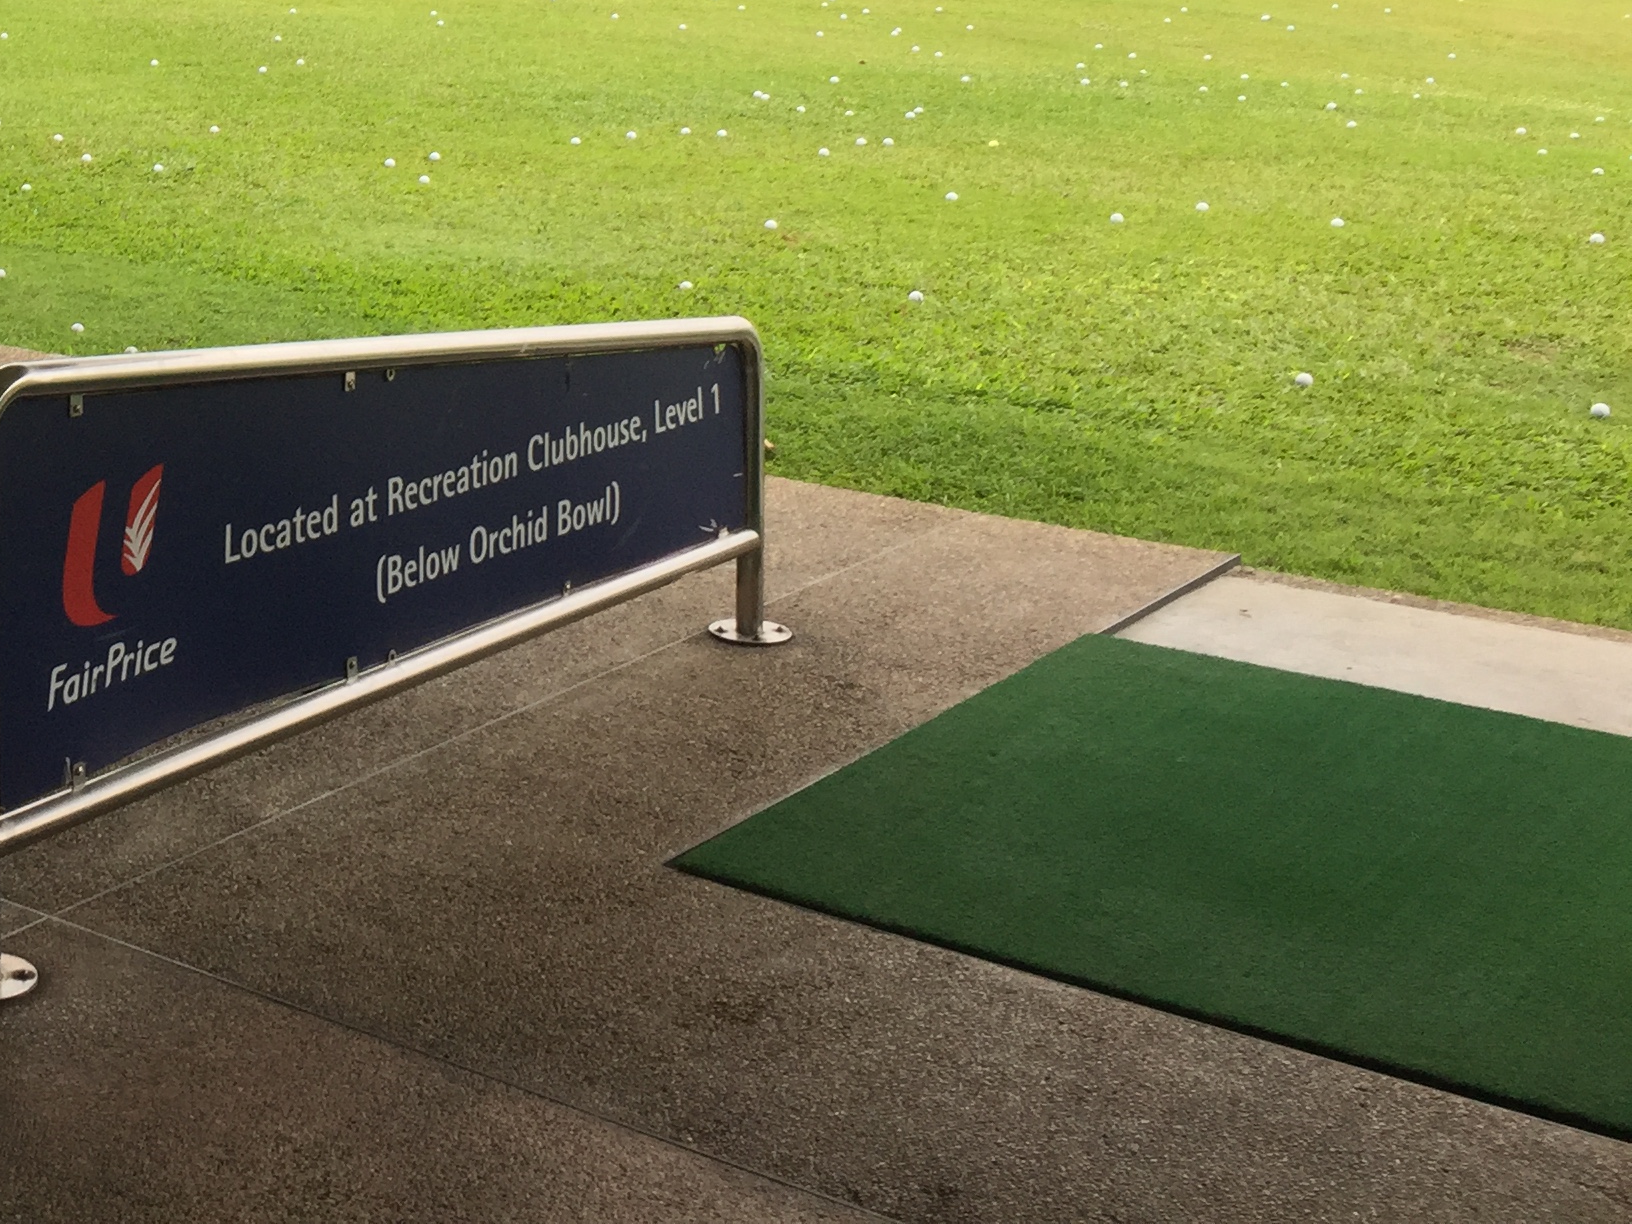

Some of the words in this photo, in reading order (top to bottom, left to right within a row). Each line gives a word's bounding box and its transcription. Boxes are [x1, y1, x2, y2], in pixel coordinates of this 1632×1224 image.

[224, 495, 339, 564] Located
[350, 487, 378, 528] at
[388, 449, 518, 515] Recreation
[527, 415, 648, 473] Clubhouse,
[654, 385, 704, 434] Level
[710, 382, 721, 415] 1
[376, 544, 460, 604] (Below
[469, 505, 548, 564] Orchid
[557, 480, 620, 536] Bowl)
[47, 636, 177, 712] FairPrice
